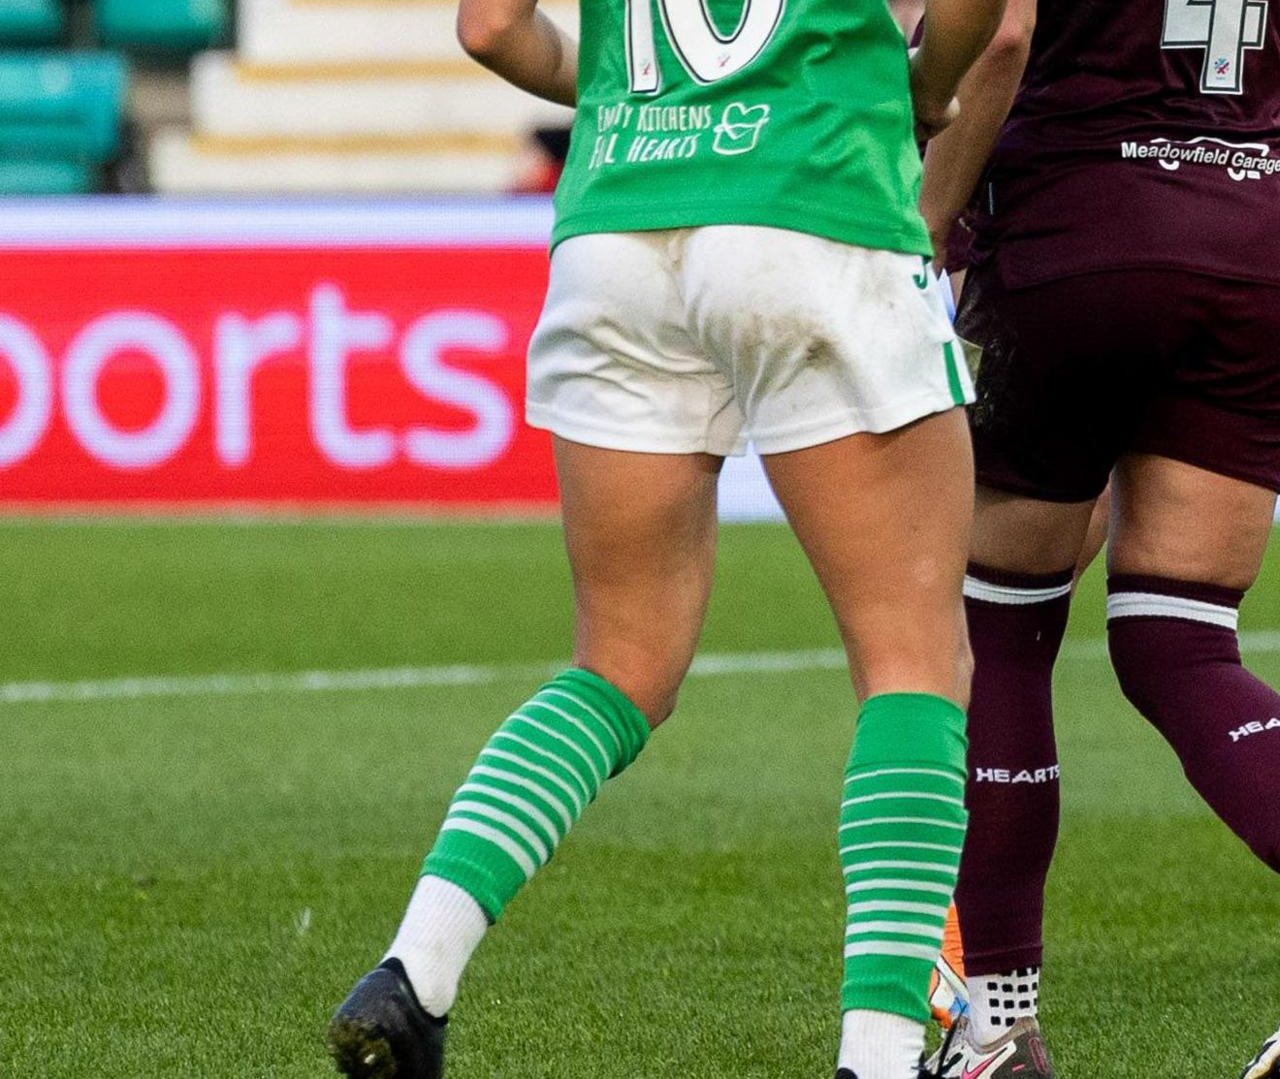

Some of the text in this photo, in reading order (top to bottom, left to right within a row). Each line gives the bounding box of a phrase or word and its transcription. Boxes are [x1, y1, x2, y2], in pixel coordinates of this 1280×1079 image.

[636, 104, 712, 132] KITCHENS
[627, 133, 701, 163] HEARTS
[1121, 142, 1229, 165] Meadowfield
